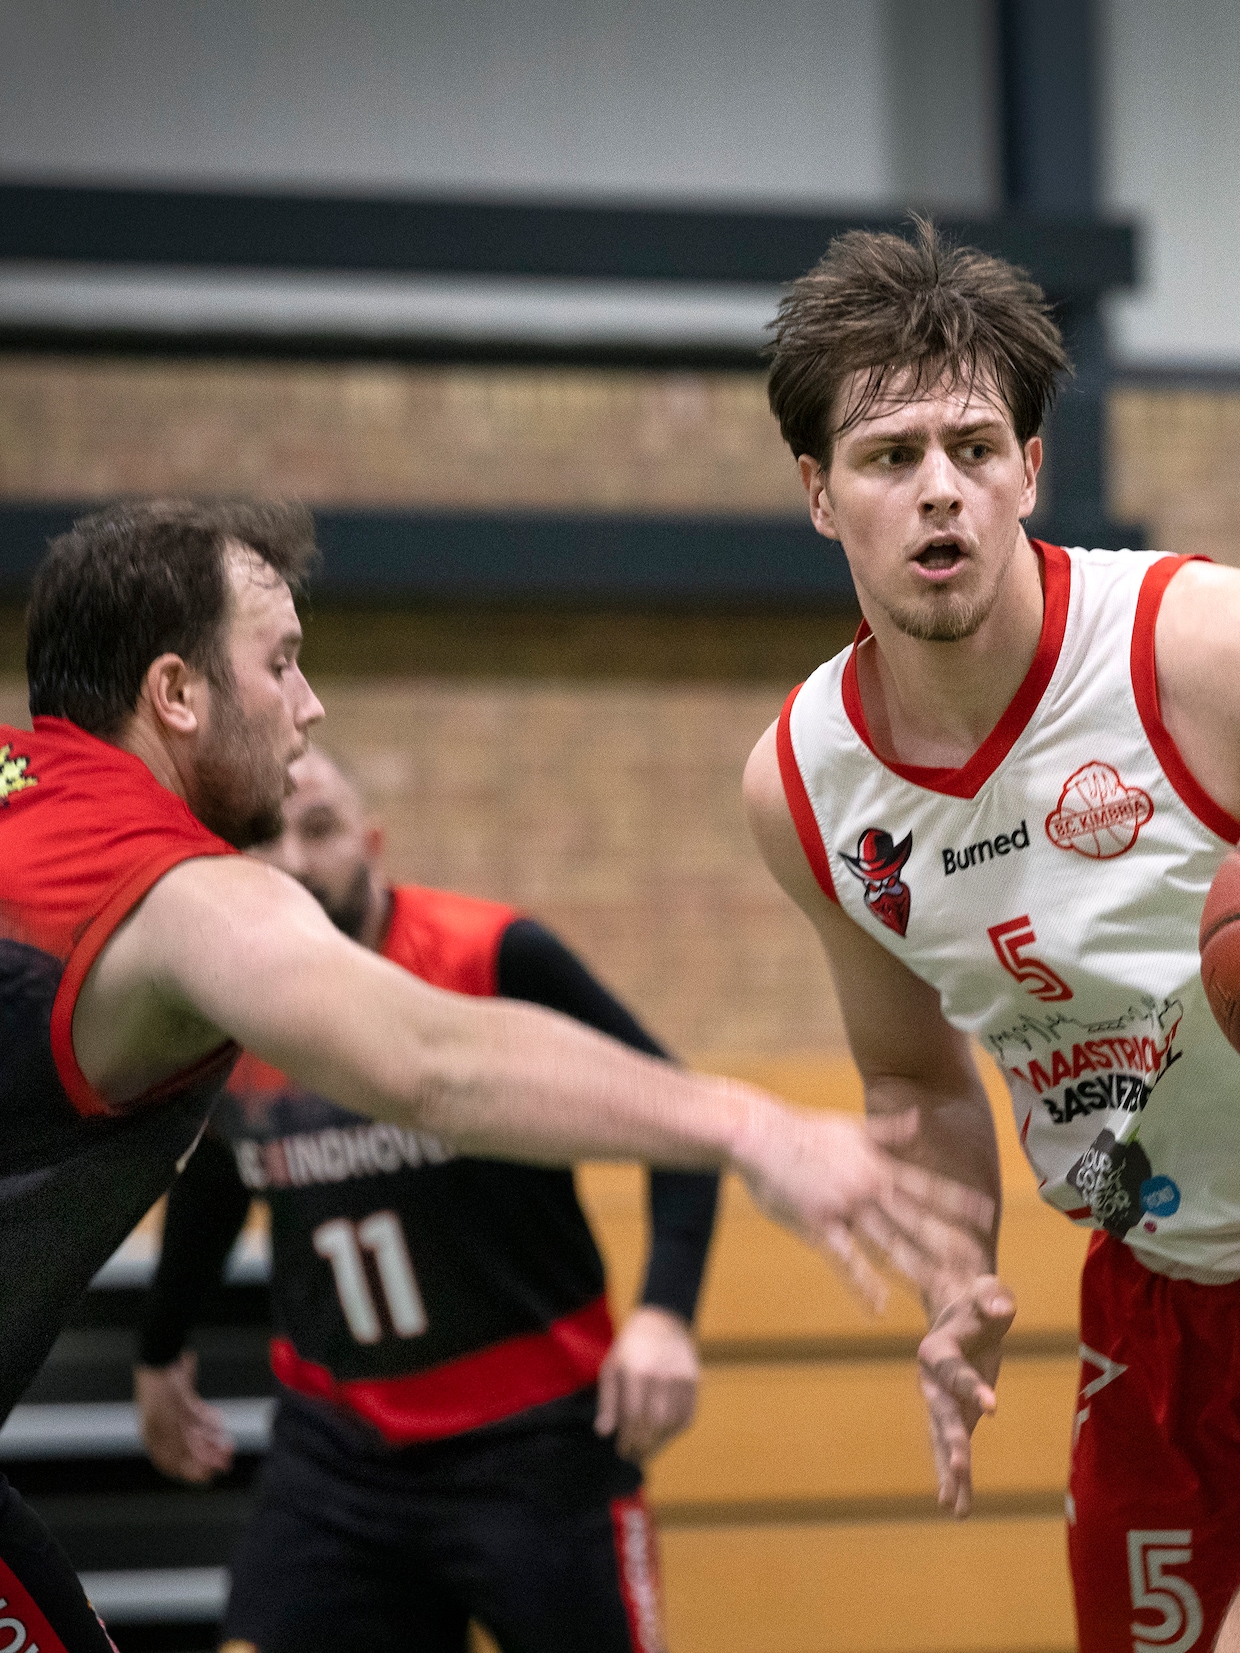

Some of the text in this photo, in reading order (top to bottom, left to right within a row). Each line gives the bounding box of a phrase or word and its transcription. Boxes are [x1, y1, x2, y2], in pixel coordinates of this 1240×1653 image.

[942, 819, 1031, 877] Burned
[987, 913, 1075, 1003] 5
[311, 1211, 429, 1345] 11
[1126, 1528, 1204, 1653] 5
